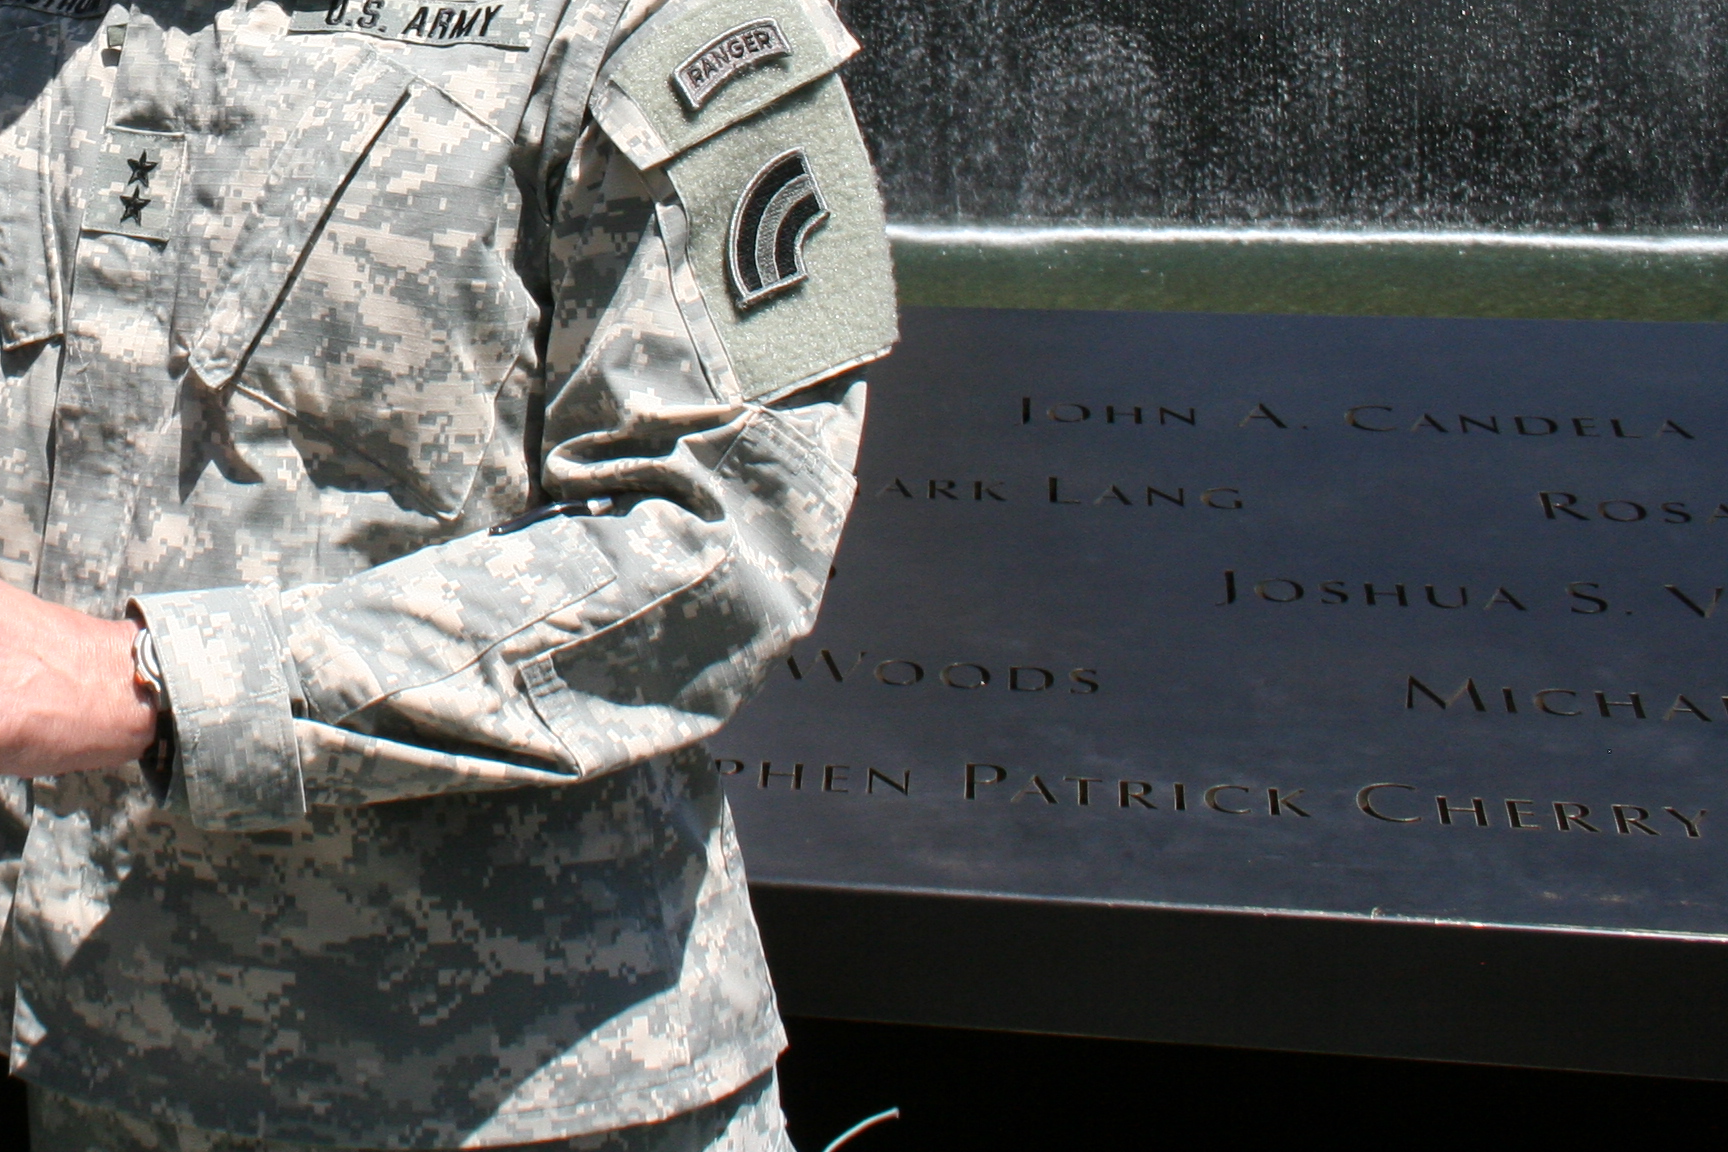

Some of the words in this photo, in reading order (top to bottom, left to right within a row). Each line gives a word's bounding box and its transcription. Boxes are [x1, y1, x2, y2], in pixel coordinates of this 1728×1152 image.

[403, 3, 504, 40] ARMY
[688, 31, 773, 86] RANGER
[1015, 394, 1198, 428] JOHN
[1239, 401, 1311, 431] A.
[1343, 403, 1696, 442] CANDELA
[855, 472, 1008, 504] ARK
[1047, 474, 1245, 512] LANG
[1214, 568, 1528, 613] JOSHUA
[1566, 580, 1636, 617] S.
[780, 647, 1101, 696] WOODS
[1404, 673, 1728, 725] MICHA
[714, 757, 912, 798] PHEN
[962, 760, 1312, 820] PATRICK
[1354, 781, 1709, 841] CHERRY
